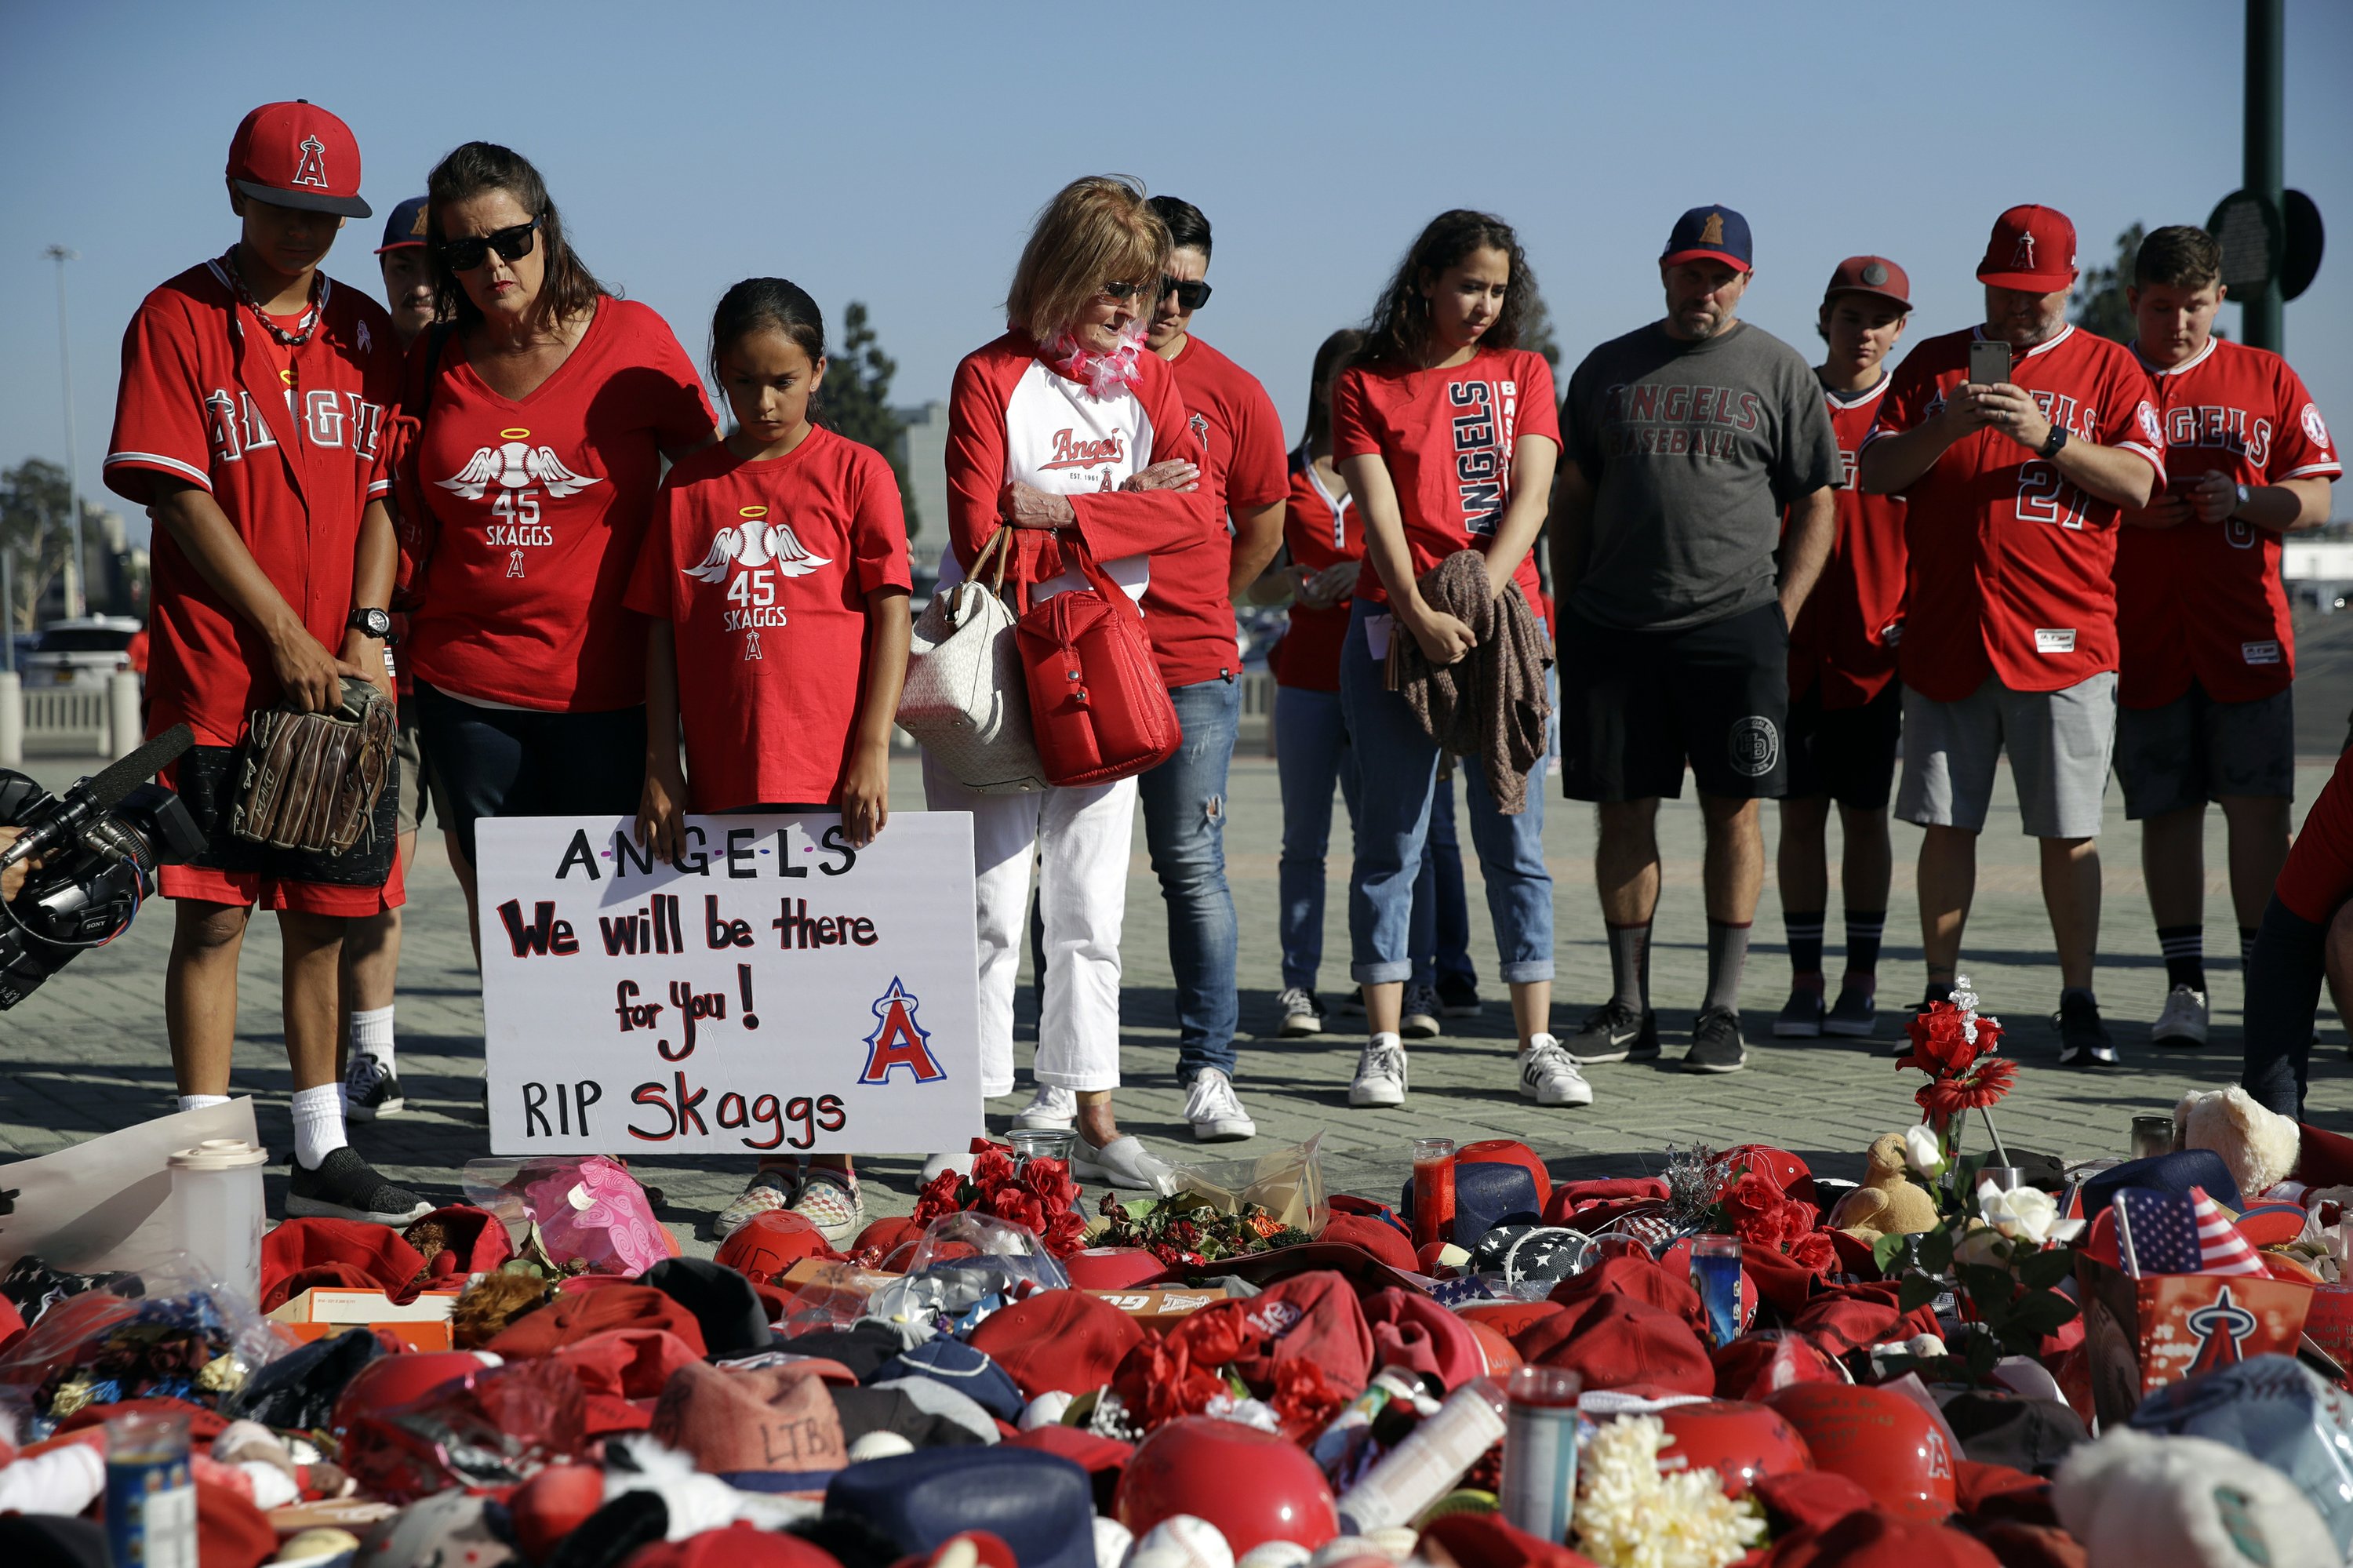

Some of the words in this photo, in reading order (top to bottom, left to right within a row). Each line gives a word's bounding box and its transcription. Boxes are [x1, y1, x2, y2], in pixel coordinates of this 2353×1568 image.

[293, 134, 328, 187] A
[2009, 230, 2035, 269] A
[1602, 375, 1761, 432] ANGELS
[1449, 380, 1504, 537] ANGELS
[2165, 405, 2272, 468] GELS
[492, 489, 540, 525] 45
[486, 526, 553, 546] SKAGGS
[506, 548, 525, 578] A
[726, 569, 775, 608] 45
[724, 606, 787, 632] SKAGGS
[744, 631, 762, 660] A
[86, 920, 106, 930] SONY
[496, 897, 580, 959] We
[598, 893, 684, 956] will
[704, 893, 755, 950] be
[772, 897, 879, 950] there
[614, 979, 664, 1032] for
[856, 974, 947, 1085] A
[522, 1079, 602, 1138] RIP
[627, 1071, 847, 1150] Skaggs
[1926, 1424, 1951, 1480] A
